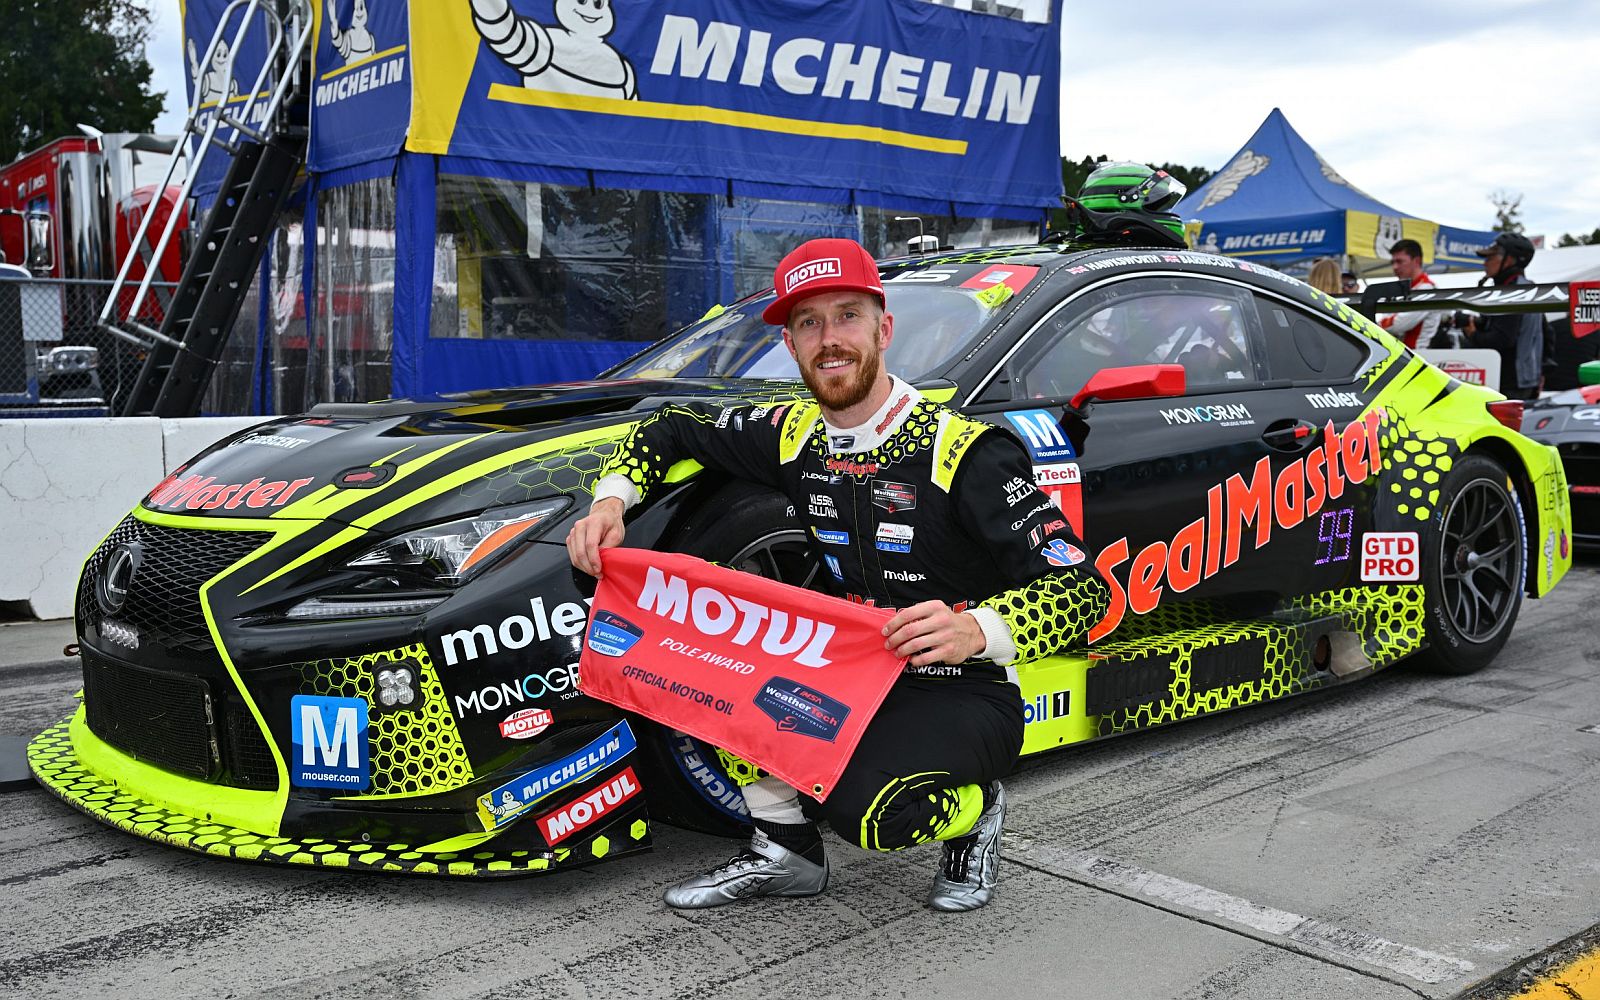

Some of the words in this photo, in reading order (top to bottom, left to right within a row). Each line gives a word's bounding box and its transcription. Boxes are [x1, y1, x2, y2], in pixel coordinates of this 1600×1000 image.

[650, 14, 1041, 125] MICHELIN
[316, 58, 404, 107] MICHELIN
[1222, 229, 1326, 250] MICHELIN
[788, 262, 837, 285] MOTUL
[1085, 254, 1161, 271] HAWKSWORTH
[1179, 254, 1237, 270] BARNICOAT
[1305, 387, 1364, 409] molex
[1160, 403, 1252, 425] MONOGRAM
[1012, 413, 1066, 448] M
[943, 425, 976, 471] HRX
[1037, 449, 1071, 458] mouser.com
[808, 504, 839, 520] SULLIVAN
[809, 493, 835, 508] VASSER
[818, 533, 845, 541] MICHELIN
[1088, 409, 1384, 645] SealMaster
[1314, 508, 1354, 565] 99
[1041, 539, 1073, 565] VP
[1365, 537, 1415, 556] GTD
[884, 569, 926, 582] molex
[1364, 558, 1415, 577] PRO
[636, 565, 836, 669] MOTUL
[441, 597, 594, 666] mole
[600, 630, 627, 644] MICHELIN
[659, 636, 701, 658] POLE
[700, 651, 756, 676] AWARD
[455, 663, 581, 719] MONOGR
[560, 691, 580, 701] YOUR
[622, 665, 668, 691] OFFICIAL
[669, 680, 719, 708] MOTOR
[714, 698, 735, 716] OIL
[800, 690, 823, 705] IMSA
[765, 685, 838, 727] WeatherTech
[1023, 695, 1047, 724] bil
[301, 705, 360, 769] M
[503, 714, 551, 736] MOTUL
[302, 772, 360, 783] mouser.com
[522, 737, 620, 800] MICHELIN
[546, 774, 636, 841] MOTUL
